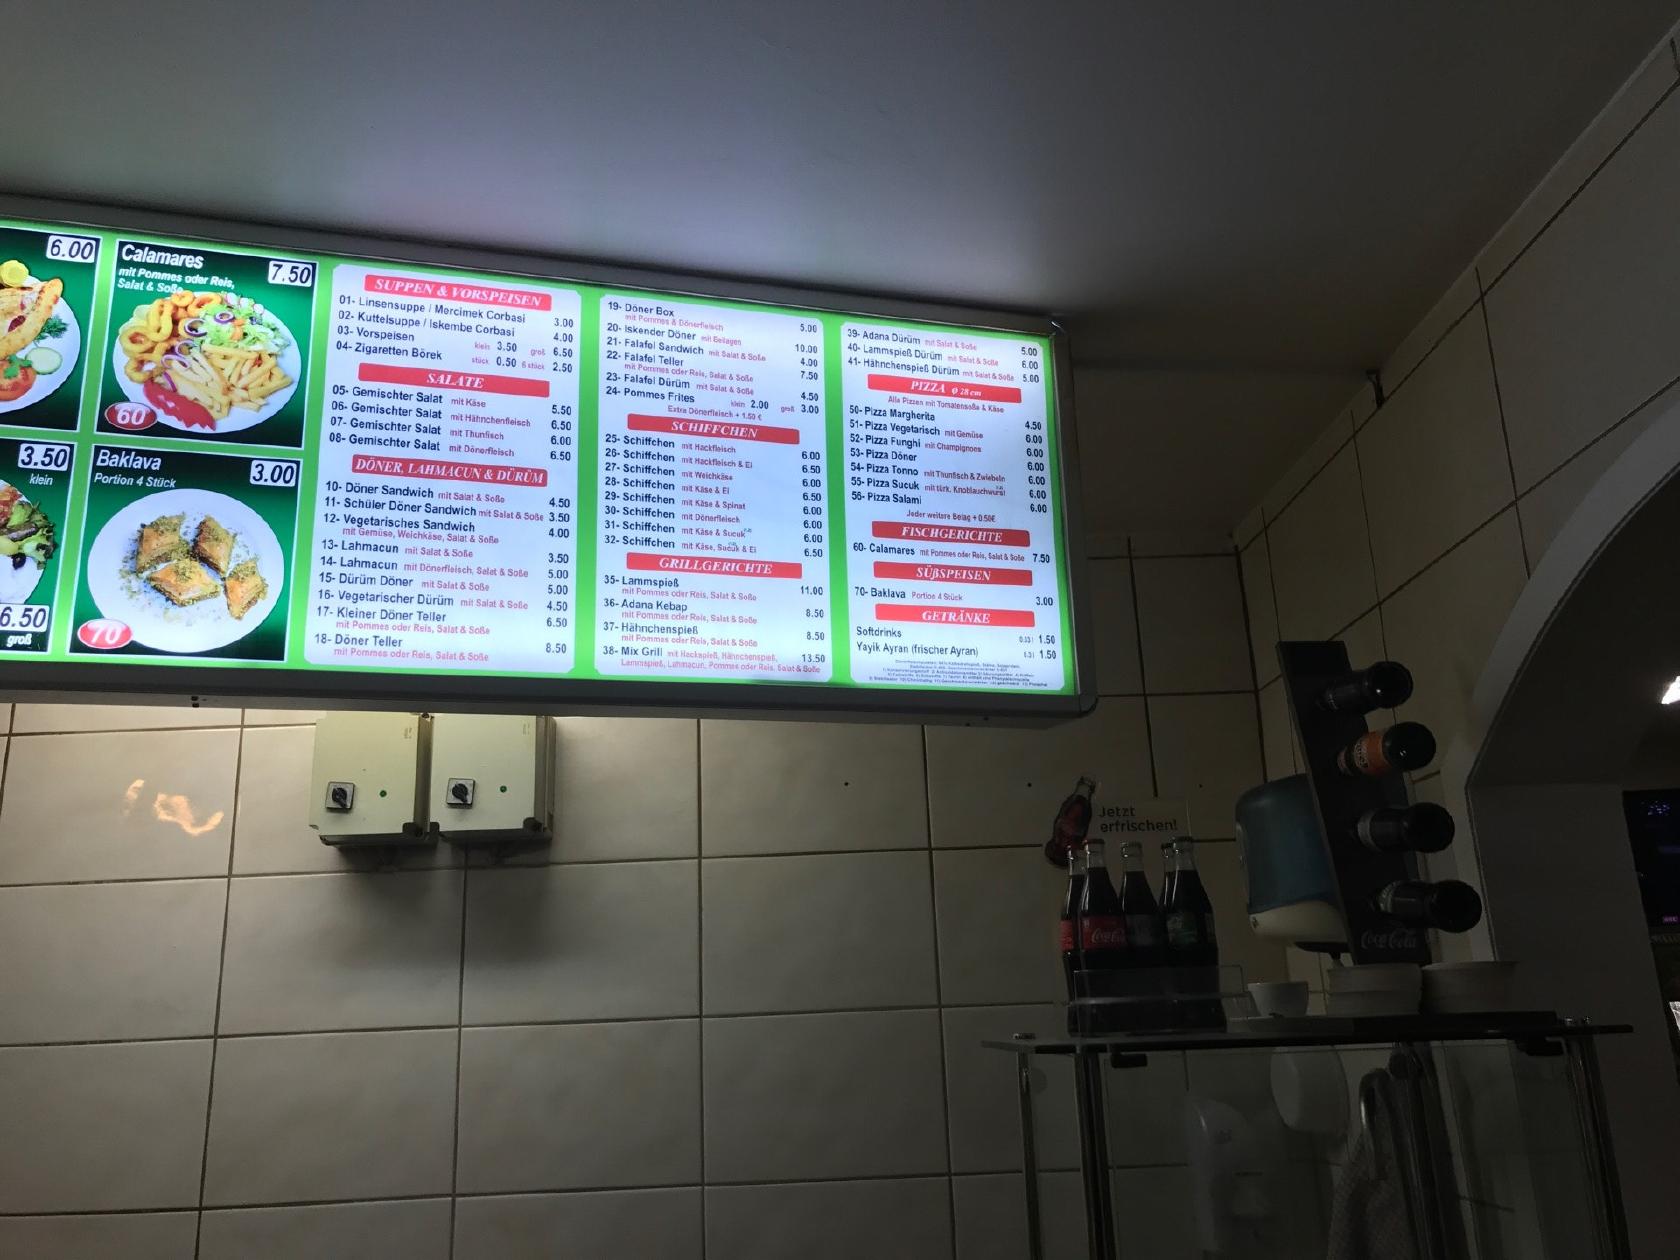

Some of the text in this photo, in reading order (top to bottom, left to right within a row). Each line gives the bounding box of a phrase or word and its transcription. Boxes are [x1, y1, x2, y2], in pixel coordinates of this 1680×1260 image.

[50, 239, 94, 259] 6.00
[121, 244, 204, 268] Calamares
[119, 268, 235, 289] mit Pommes oder Reis,
[272, 264, 311, 284] 7.50
[117, 279, 143, 290] Salat
[146, 282, 153, 292] &
[375, 279, 541, 306] SUPPEN & VORSPEISEN
[339, 295, 573, 327] 01- Linsensuppe / Mercimek Corbasi 3.00
[608, 302, 817, 333] 19- Döner Box 5.00
[338, 311, 573, 342] 02- Kuttelsuppe / Iskembe Corbasi 4.00
[337, 326, 353, 335] 03-
[357, 327, 414, 343] Vorspeisen
[497, 341, 517, 351] 3.50
[553, 348, 573, 357] 6.50
[336, 341, 352, 350] 04-
[355, 343, 408, 357] Zigaretten
[412, 346, 442, 361] Börek
[496, 357, 516, 367] 0.50
[553, 362, 572, 373] 2.50
[427, 373, 484, 389] SALATE
[911, 381, 946, 393] PIZZA
[960, 387, 968, 396] 28
[333, 385, 348, 395] 05-
[352, 386, 413, 401] Gemischter
[416, 392, 443, 404] Salat
[465, 398, 486, 408] Käse
[552, 405, 571, 415] 5.50
[606, 386, 620, 396] 24-
[624, 388, 665, 400] Pommes
[669, 392, 695, 403] Frites
[751, 400, 769, 409] 2.00
[801, 405, 819, 414] 3.00
[117, 408, 146, 424] 60
[331, 401, 571, 431] 06- Gemischter Salat mit Hähnchenfleisch 6.50
[850, 405, 1042, 430] 50- Pizza Margherita 4.50
[671, 421, 758, 438] SCHIFFCHEN
[850, 420, 863, 429] 51-
[865, 421, 887, 431] Pizza
[890, 423, 940, 437] Vegetarisch
[956, 429, 983, 439] Gemüse
[1026, 435, 1042, 444] 6.00
[606, 433, 820, 460] 25- Schiffchen mit Hackfleisch 6.00
[21, 447, 68, 467] 3.50
[96, 451, 162, 470] Baklava
[30, 474, 53, 485] klein
[94, 473, 176, 488] Portion 4 Stück
[253, 465, 294, 484] 3.00
[356, 458, 544, 484] DÖNER, LAHMACUN & DÜRÜM
[326, 481, 342, 491] 10-
[345, 482, 378, 494] Döner
[382, 485, 433, 499] Sandwich
[438, 491, 451, 499] mit
[453, 492, 473, 501] Salat
[476, 493, 482, 501] &
[549, 497, 570, 508] 4.50
[605, 491, 620, 501] 29-
[622, 493, 675, 505] Schiffchen
[695, 500, 713, 508] Käse
[722, 501, 746, 510] Spinat
[803, 506, 822, 515] 6.00
[851, 491, 1047, 513] 56- Pizza Salami 6.00
[324, 513, 569, 538] 12- Vegetarisches Sandwich 4.00
[902, 527, 1003, 542] FISCHGERICHTE
[853, 543, 1050, 563] 60- Calamares 7.50
[659, 558, 773, 574] GRILLGERICHTE
[604, 575, 823, 595] 35- Lammspieß 11.00
[855, 587, 868, 596] 70-
[871, 588, 905, 598] Baklava
[944, 593, 963, 601] Stück
[1036, 597, 1053, 605] 3.00
[1, 608, 46, 627] 6.50
[604, 599, 824, 618] 36- Adana Kebap 8.50
[922, 610, 990, 623] GETRÄNKE
[7, 634, 32, 646] groß
[92, 626, 121, 641] 70
[857, 627, 902, 638] Softdrinks
[1039, 635, 1055, 644] 1.50
[857, 642, 880, 653] Yayik
[883, 643, 908, 654] Ayran
[911, 645, 948, 656] (frischer
[950, 646, 979, 657] Ayran)
[1040, 650, 1056, 659] 1.50
[1100, 806, 1135, 817] Jetzt
[1101, 819, 1177, 832] erfrischen!
